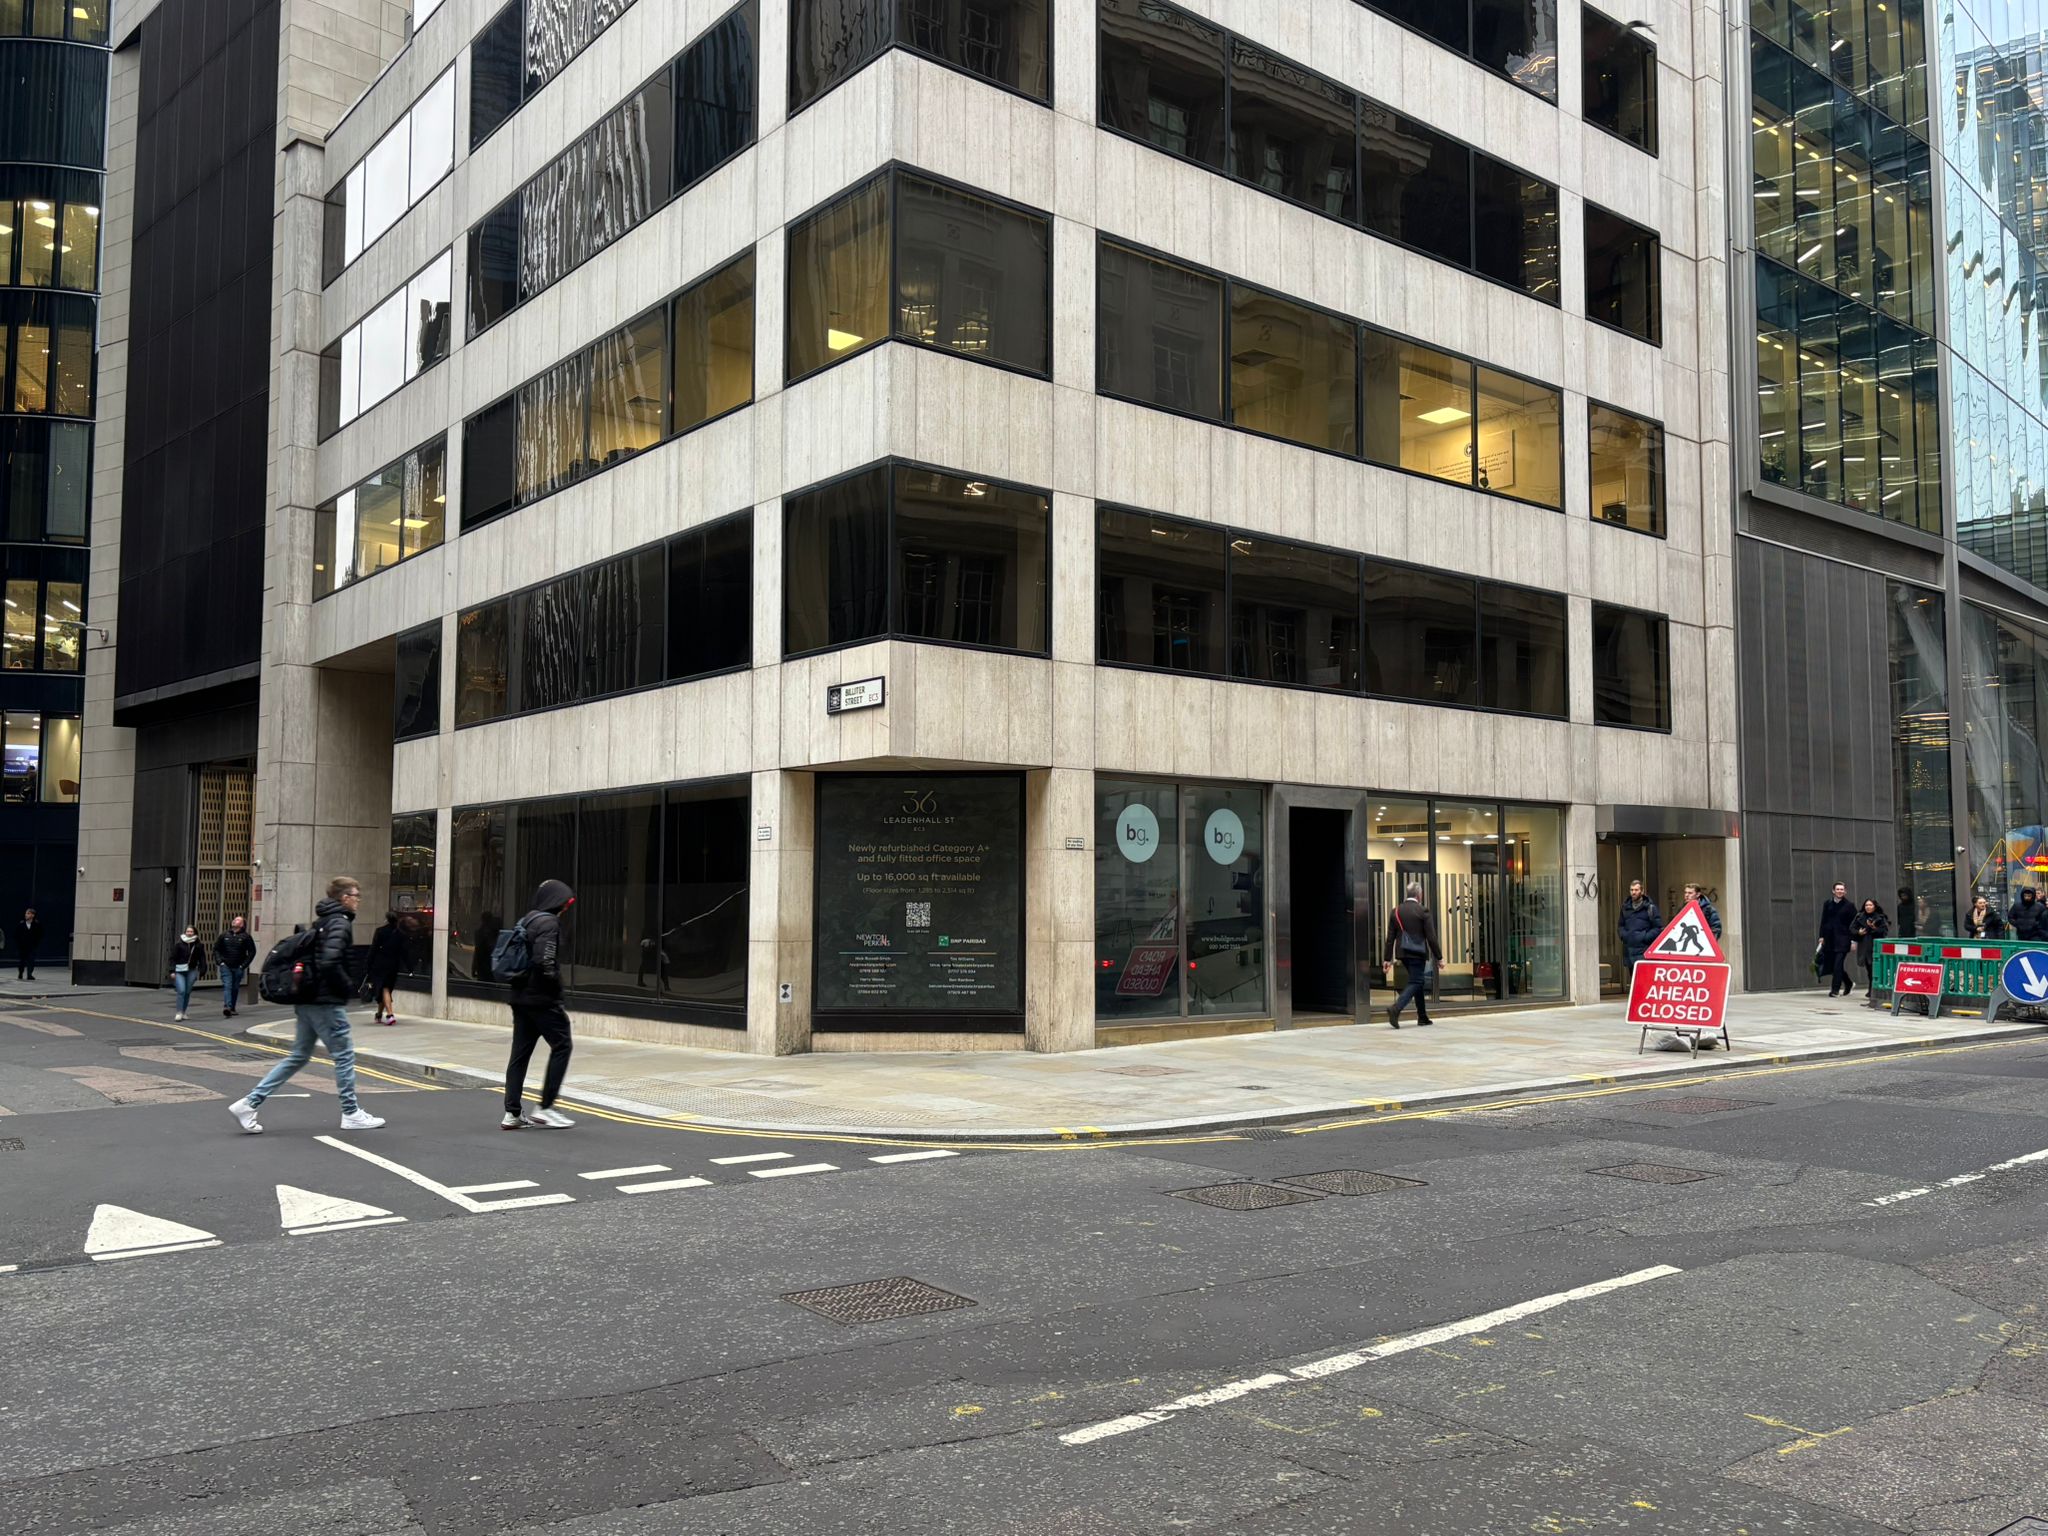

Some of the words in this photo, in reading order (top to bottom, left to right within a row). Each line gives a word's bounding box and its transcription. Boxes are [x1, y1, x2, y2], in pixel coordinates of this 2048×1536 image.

[845, 685, 865, 697] BILLITER
[845, 695, 863, 706] STREET
[868, 692, 879, 702] EC3
[902, 790, 937, 814] 36
[883, 816, 941, 824] LEADENHALL
[944, 816, 955, 824] ST
[1126, 823, 1149, 846] bg.
[1214, 827, 1235, 849] bg.
[848, 844, 876, 853] Newly
[879, 844, 930, 852] refurbished
[933, 844, 975, 854] Category
[977, 844, 990, 852] A+
[857, 854, 874, 862] and
[877, 854, 896, 864] fully
[898, 854, 924, 863] fitted
[926, 854, 951, 863] office
[953, 855, 981, 864] space
[857, 873, 870, 882] Up
[872, 873, 882, 881] to
[884, 873, 916, 882] 16,000
[918, 874, 929, 883] sq
[931, 873, 938, 881] ft
[940, 873, 981, 882] available
[1576, 873, 1598, 899] 36
[1653, 967, 1706, 983] ROAD
[1900, 966, 1940, 974] PEDESTRIANS
[1645, 985, 1710, 1002] AHEAD
[1638, 1002, 1712, 1021] CLOSED
